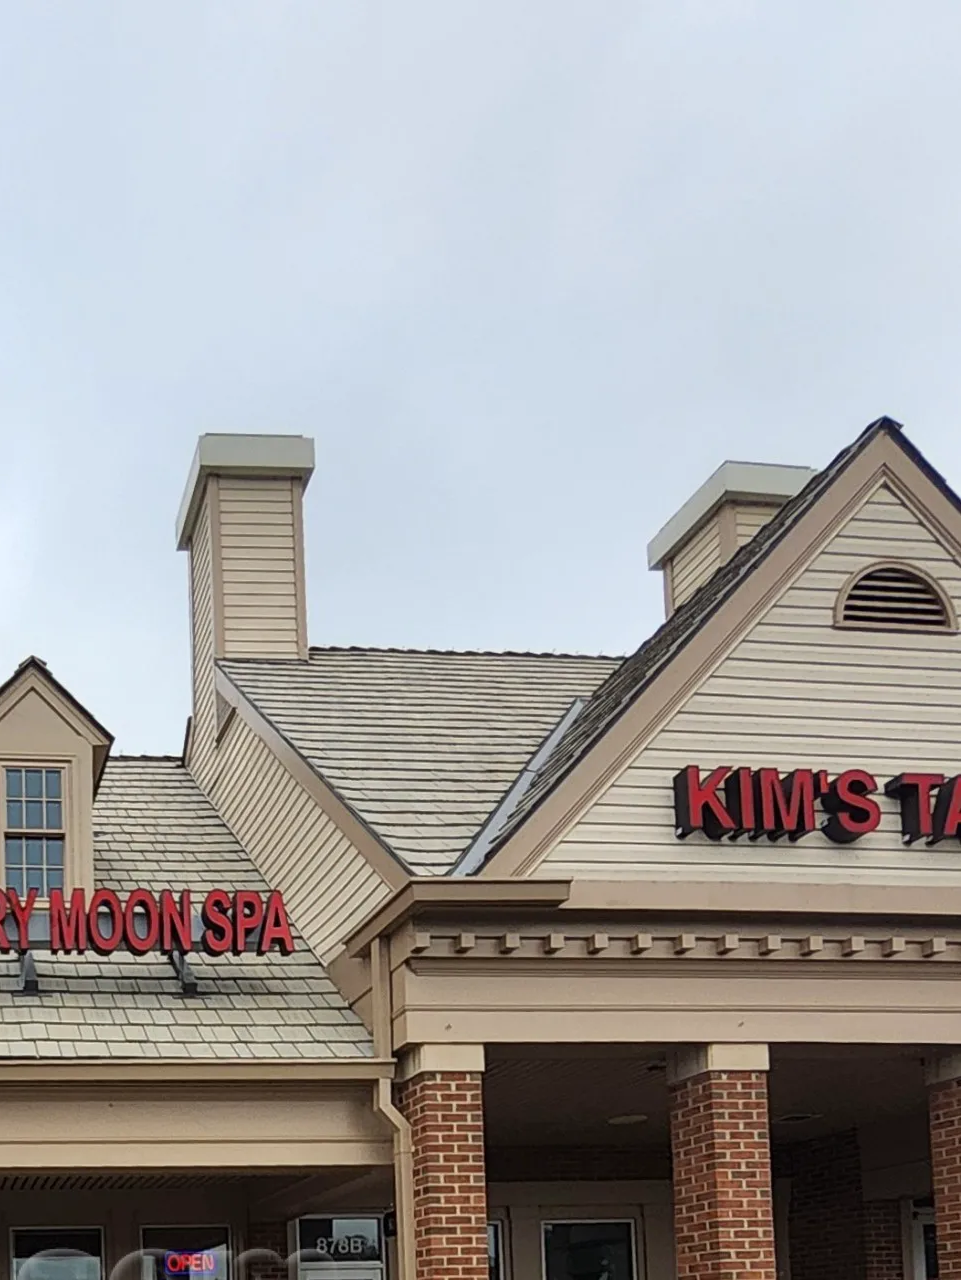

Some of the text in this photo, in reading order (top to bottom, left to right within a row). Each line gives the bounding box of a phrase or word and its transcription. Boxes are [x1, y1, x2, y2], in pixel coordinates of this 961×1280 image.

[674, 765, 881, 843] KIM'S
[49, 887, 192, 955] MOON
[201, 889, 295, 956] SPA
[167, 1254, 215, 1272] OPEN
[316, 1237, 363, 1254] 878B
